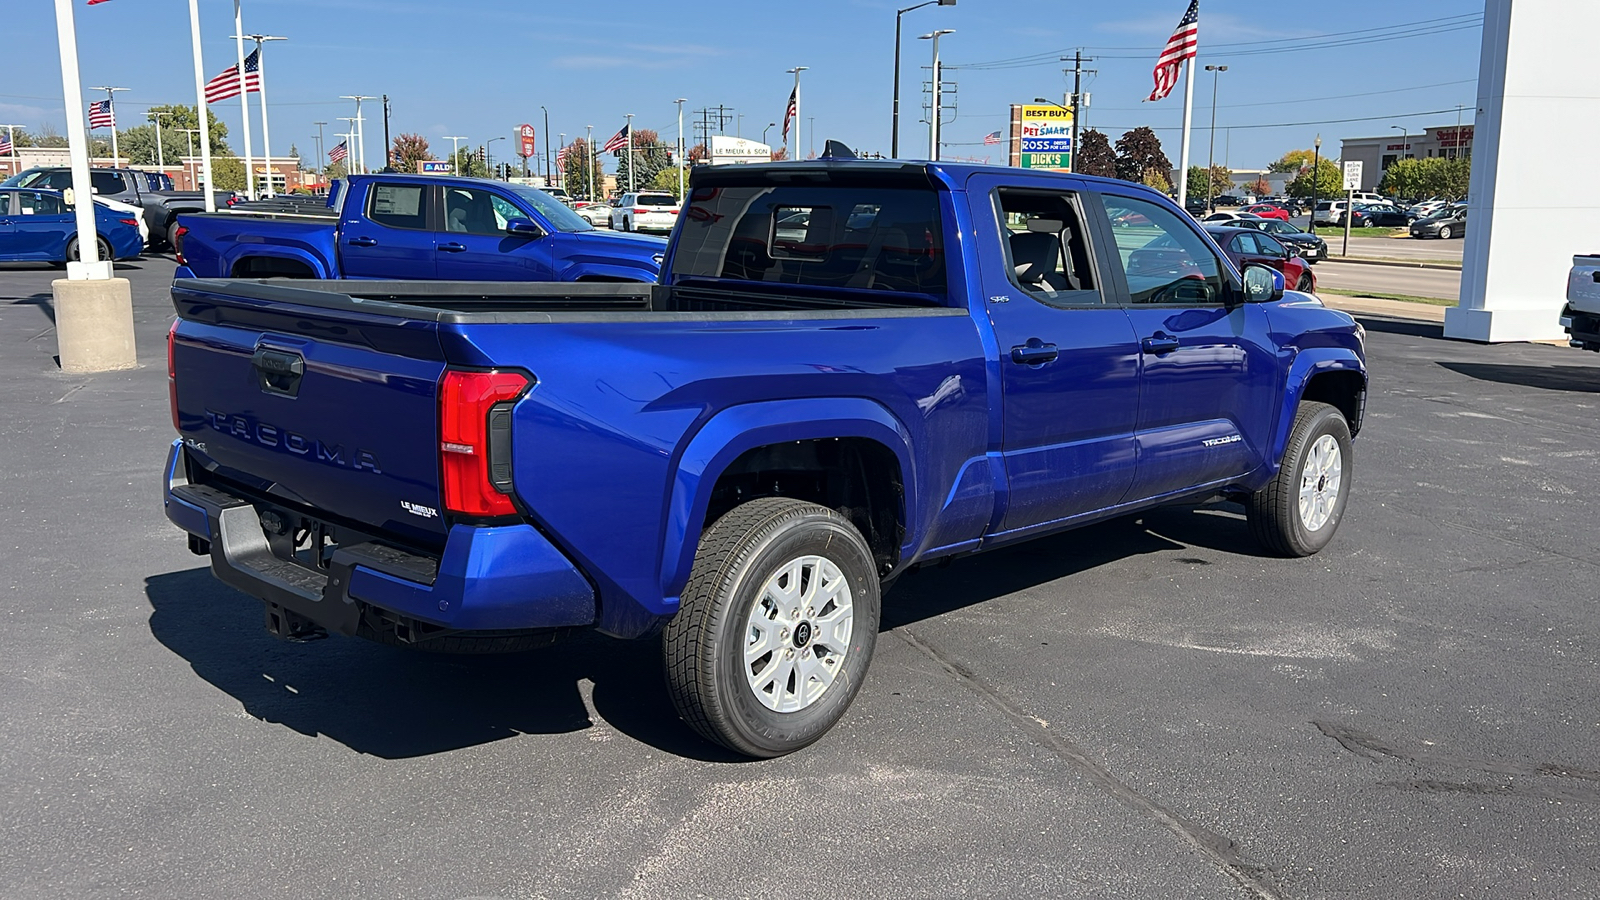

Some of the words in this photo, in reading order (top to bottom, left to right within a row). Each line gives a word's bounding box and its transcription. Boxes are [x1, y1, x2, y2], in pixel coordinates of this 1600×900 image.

[1022, 140, 1050, 150] ROSS
[1031, 154, 1061, 164] DICK'S
[989, 295, 1010, 304] SR5
[204, 408, 382, 475] TACOMA
[1201, 434, 1242, 447] TACOMA
[400, 500, 411, 510] LE
[411, 503, 439, 517] MIEUX
